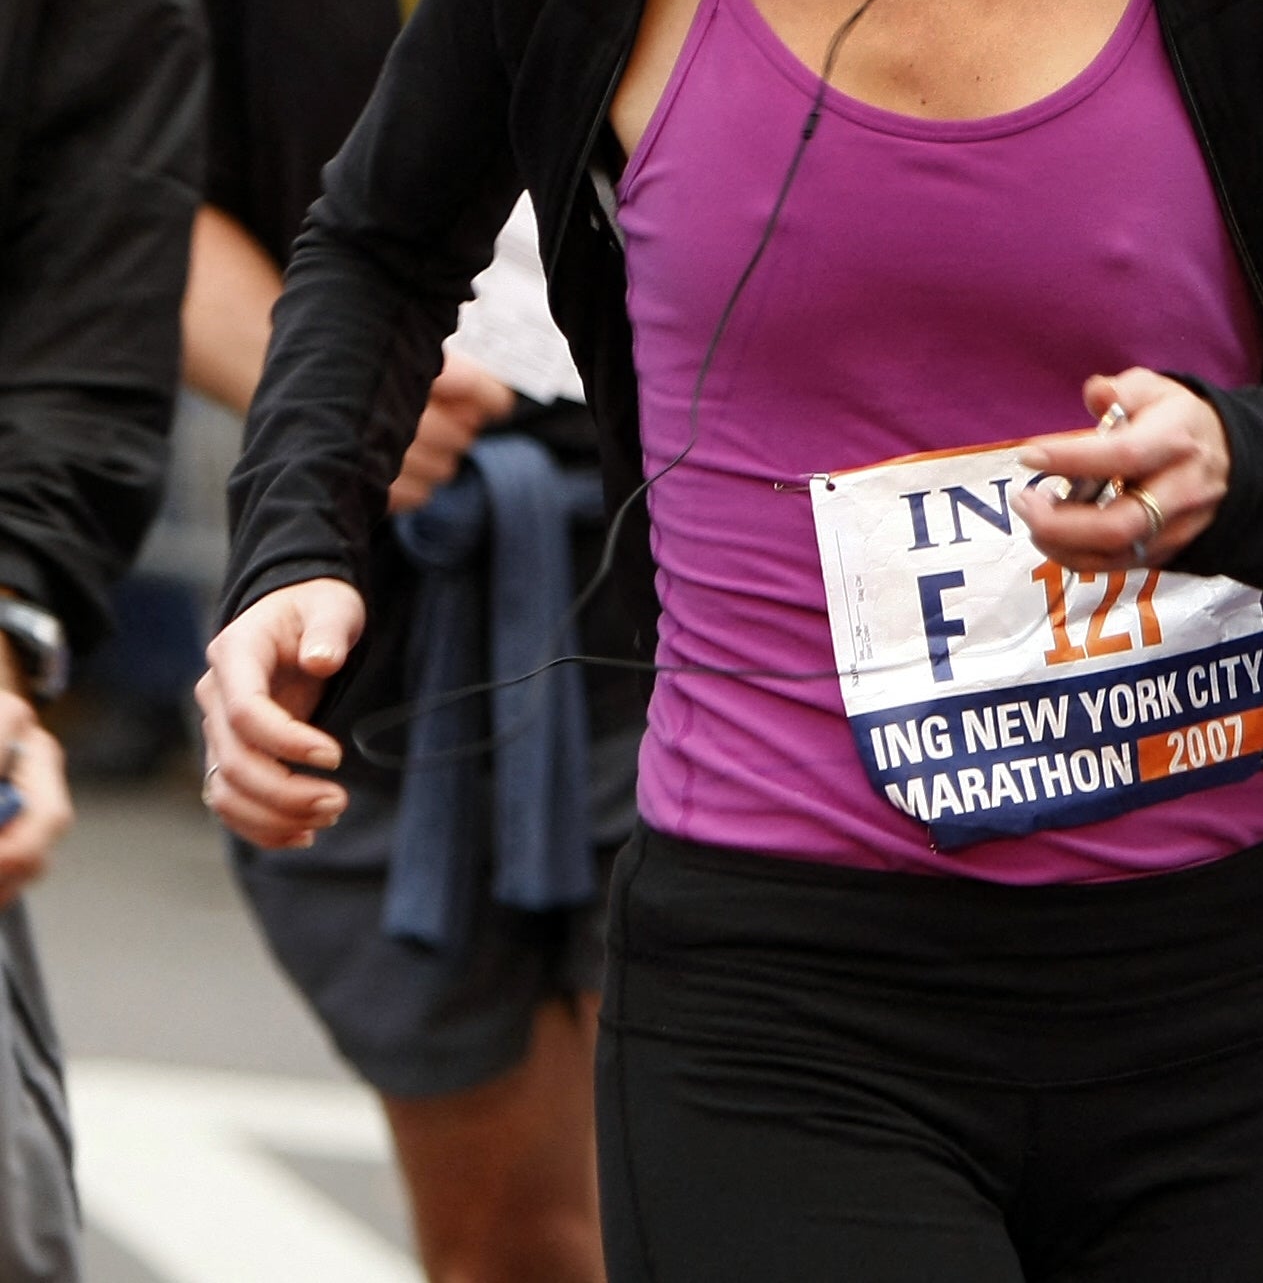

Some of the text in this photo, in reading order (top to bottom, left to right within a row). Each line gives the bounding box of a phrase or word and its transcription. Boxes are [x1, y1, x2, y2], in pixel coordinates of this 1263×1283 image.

[917, 560, 1162, 683] F 127
[870, 649, 1263, 771] ING NEW YORK CITY
[884, 715, 1244, 821] MARATHON 2007
